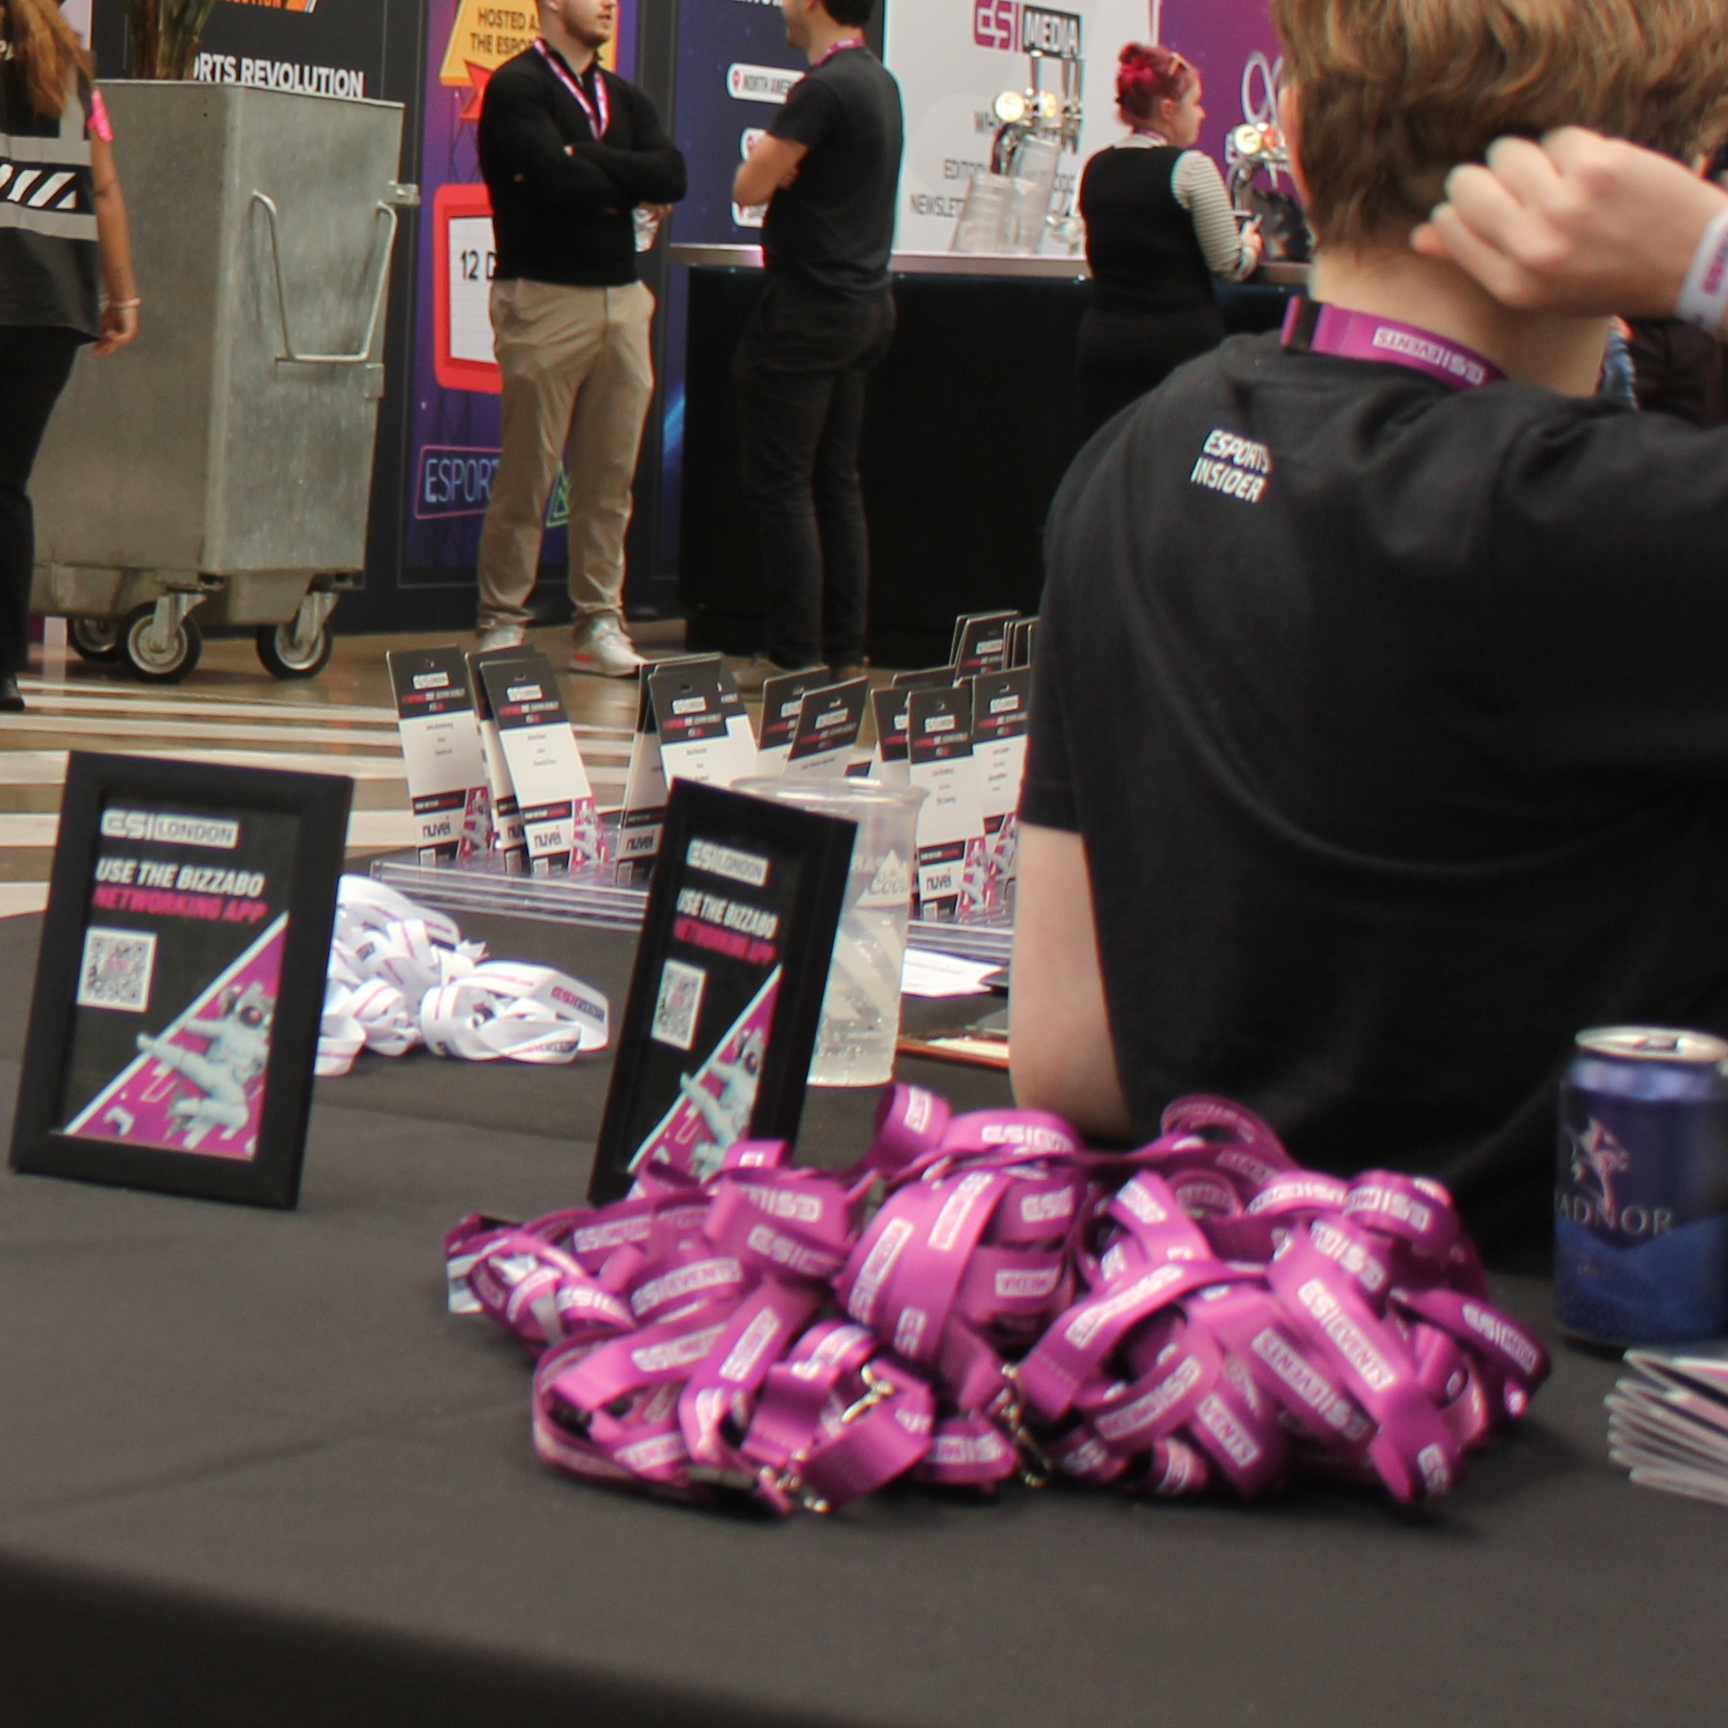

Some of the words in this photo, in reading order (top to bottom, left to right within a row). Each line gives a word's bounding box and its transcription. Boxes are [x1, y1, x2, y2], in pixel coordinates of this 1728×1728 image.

[477, 7, 525, 31] HOSTED
[471, 33, 494, 52] THE
[496, 36, 531, 55] ESPO
[241, 58, 364, 99] REVOLUTION
[460, 250, 480, 281] 12
[1203, 429, 1271, 474] ESPORTS
[1190, 456, 1266, 503] INSIDER
[157, 818, 234, 844] LONDON
[423, 815, 451, 839] nuvei
[534, 826, 563, 849] nuvei
[95, 857, 138, 884] USE
[137, 861, 179, 888] THE
[175, 864, 266, 898] BIZZABO
[926, 867, 952, 890] nuvei
[222, 898, 268, 925] APP
[700, 894, 728, 924] THE
